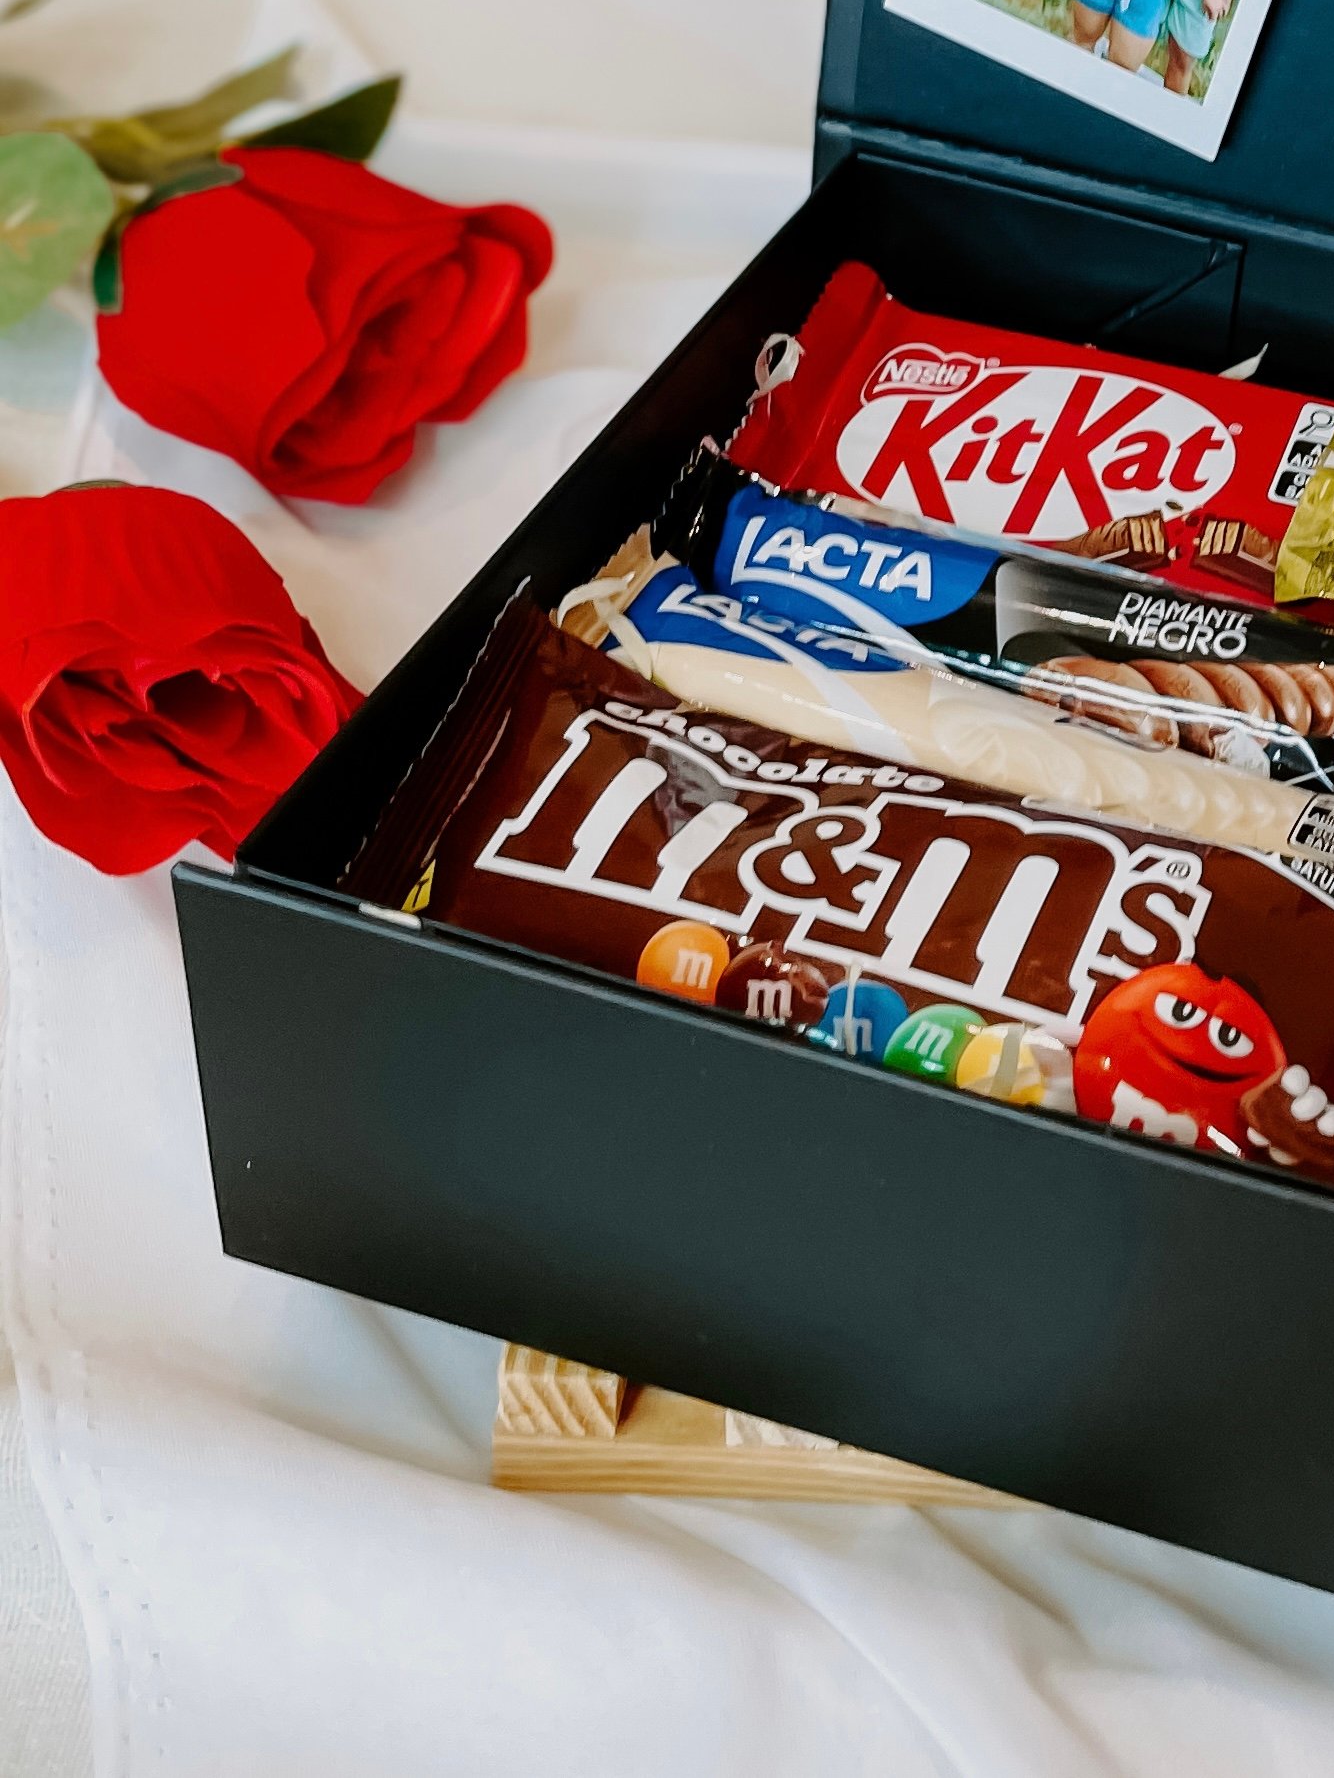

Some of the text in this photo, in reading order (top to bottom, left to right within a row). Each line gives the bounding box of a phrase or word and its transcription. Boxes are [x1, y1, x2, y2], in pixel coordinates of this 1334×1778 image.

[861, 370, 1230, 535] KitKat
[731, 515, 932, 602] LACTA
[1118, 591, 1254, 633] DIAMANTE
[1108, 613, 1247, 659] NEGRO
[604, 700, 945, 793] chocolate
[671, 948, 712, 990] m
[745, 977, 793, 1023] m
[904, 1020, 954, 1059] m
